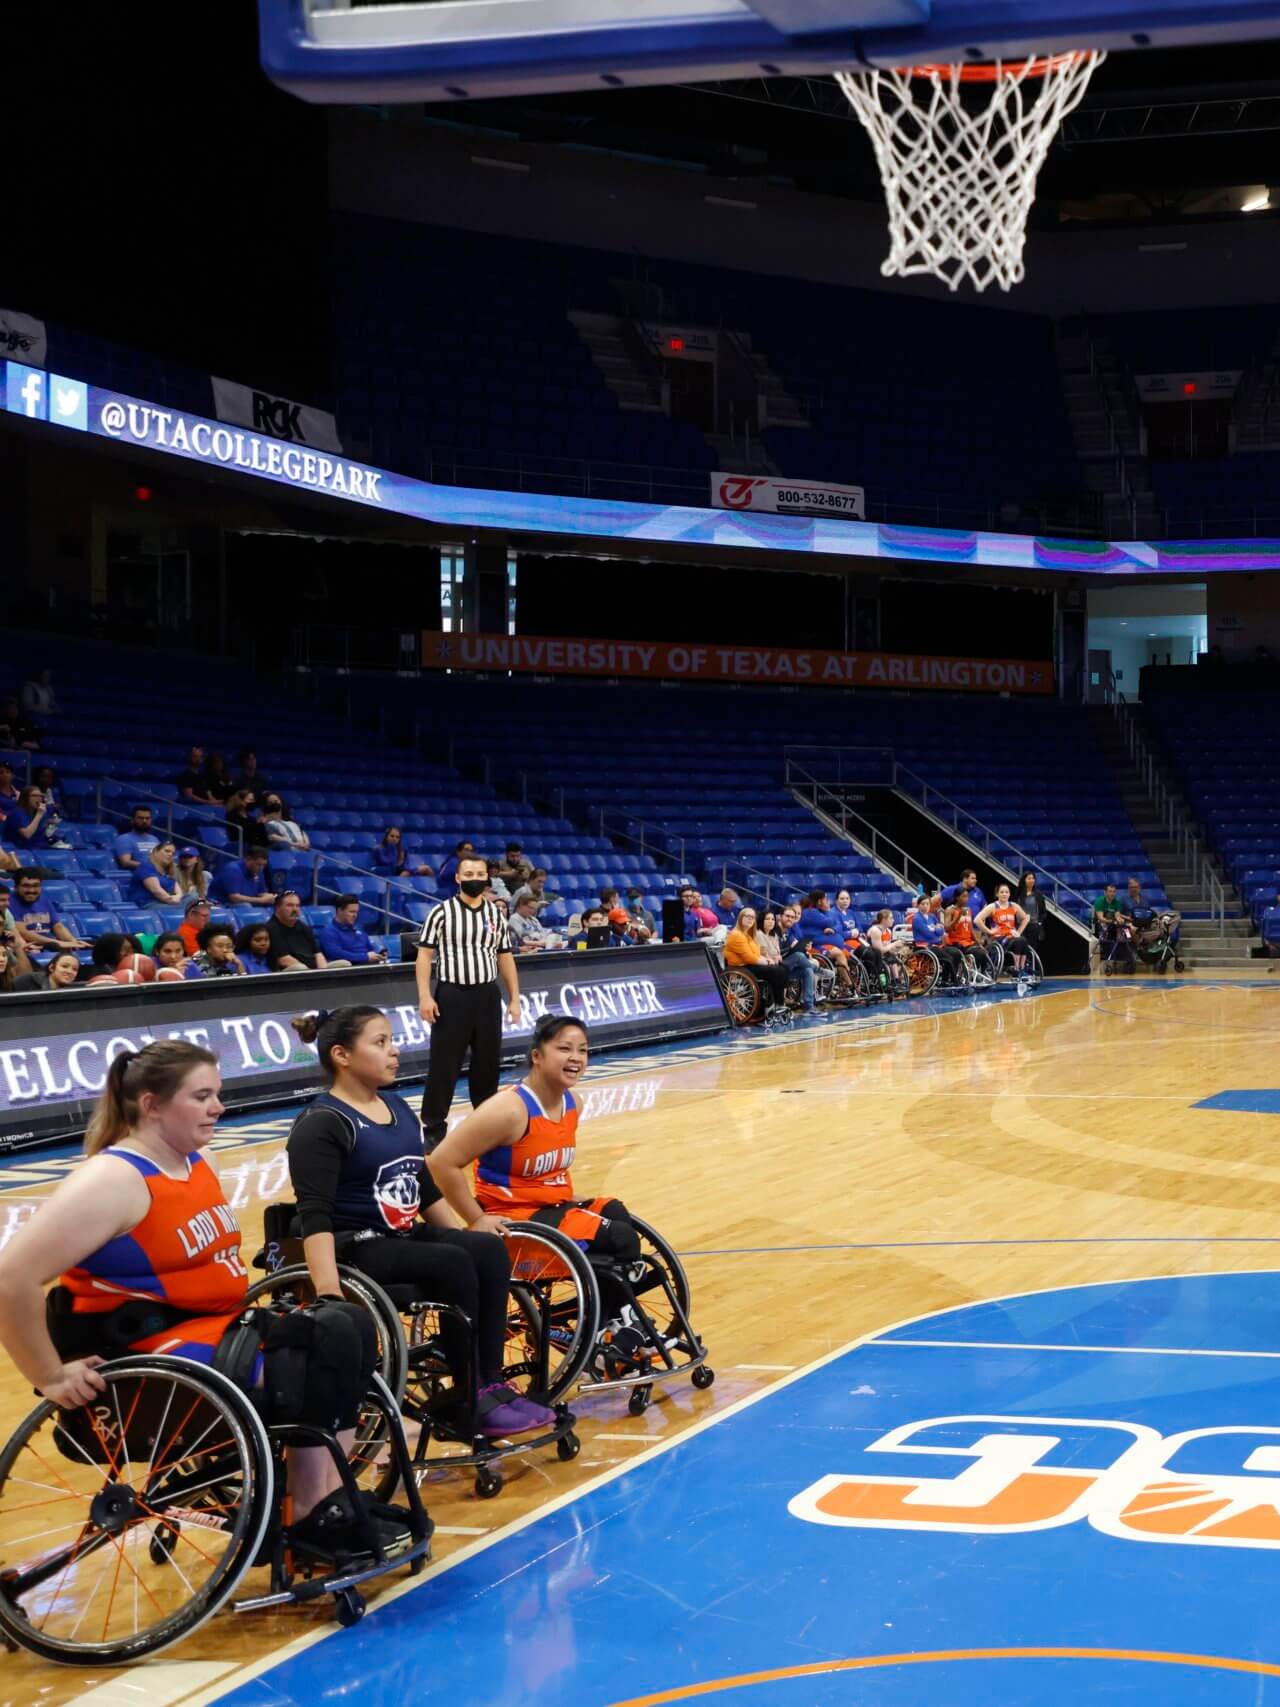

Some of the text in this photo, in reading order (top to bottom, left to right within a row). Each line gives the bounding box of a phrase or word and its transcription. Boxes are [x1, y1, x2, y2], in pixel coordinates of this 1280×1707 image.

[100, 401, 382, 501] @UTACOLLEGEPARK
[778, 491, 856, 509] 800-532-8677
[460, 638, 1026, 687] UNIVERSITY OF TEXAS AT ARLINGTON
[560, 979, 665, 1023] CENTER
[522, 1149, 559, 1177] LADY
[176, 1210, 220, 1259] LADY
